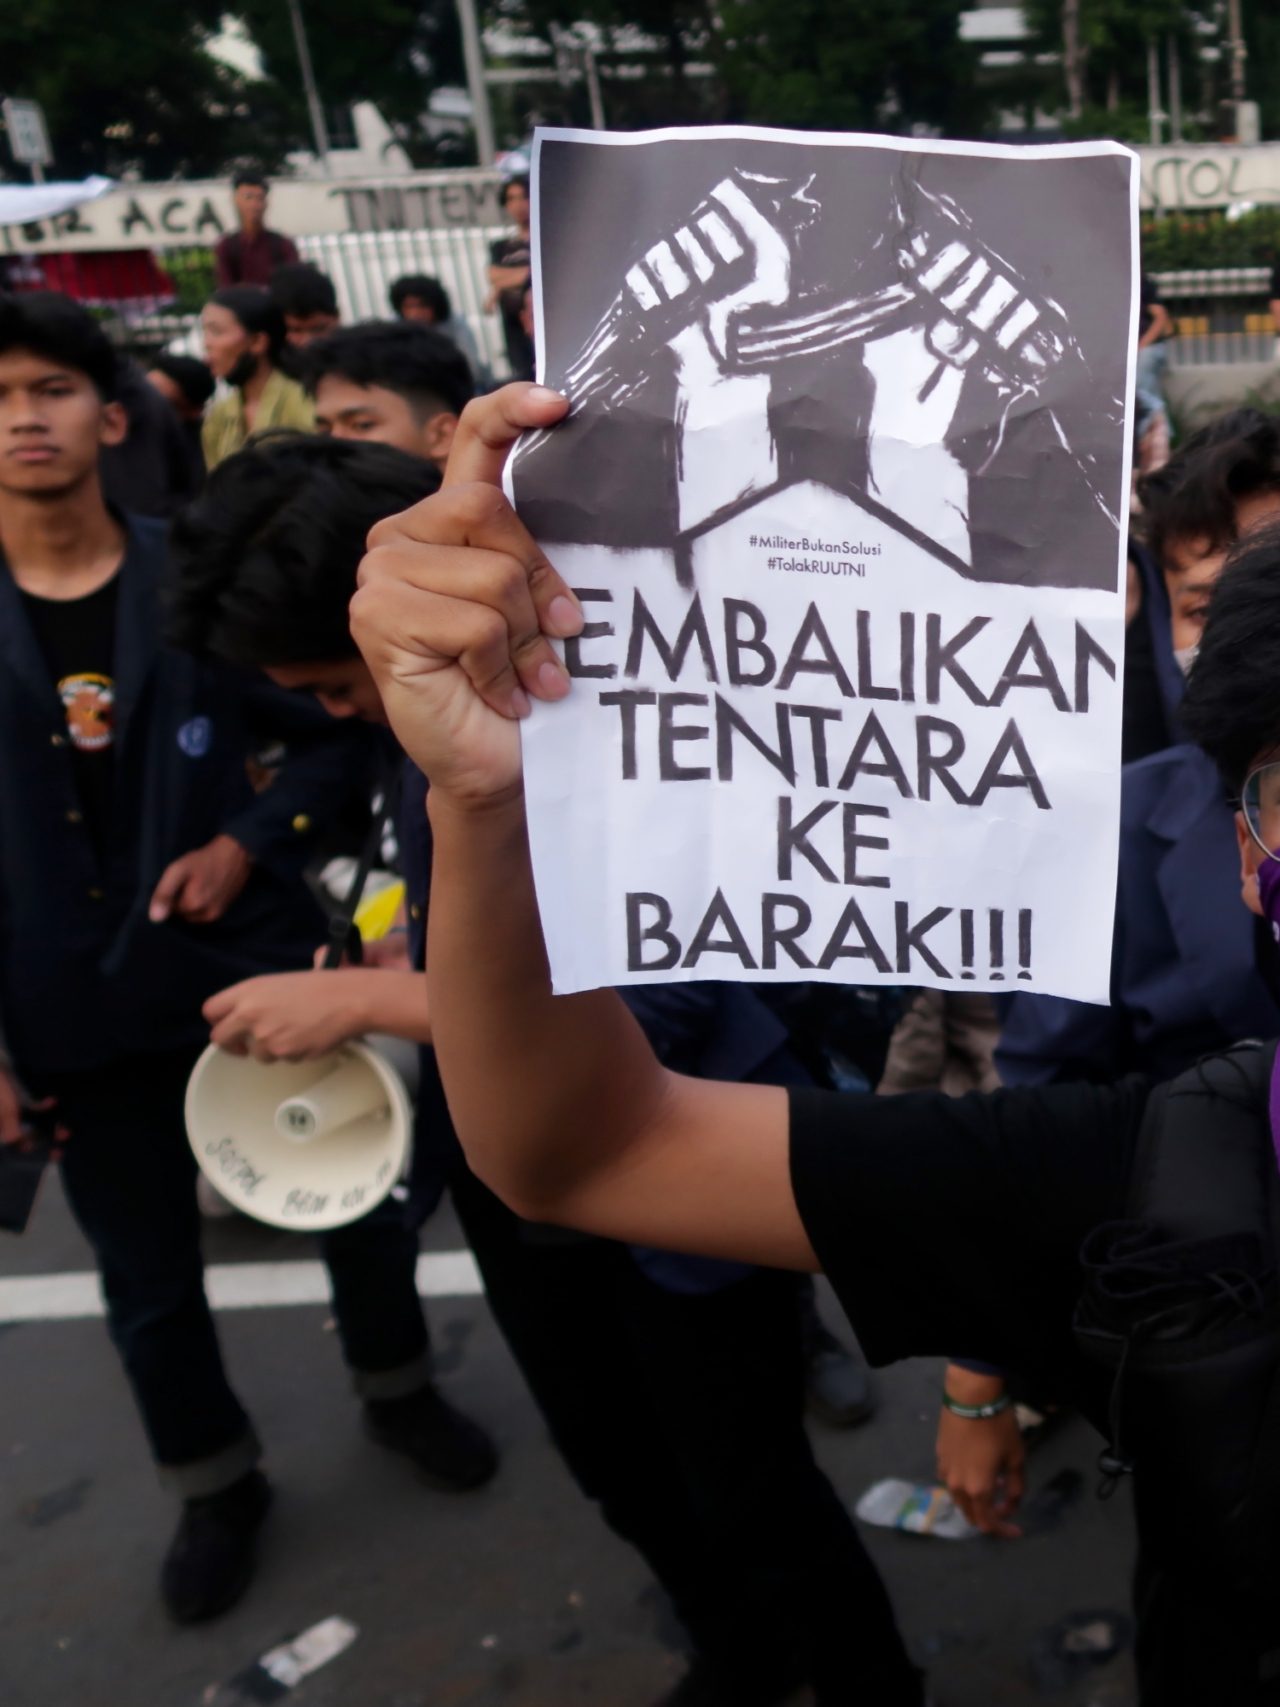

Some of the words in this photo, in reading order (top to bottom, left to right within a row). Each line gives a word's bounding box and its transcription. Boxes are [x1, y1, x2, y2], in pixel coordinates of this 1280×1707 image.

[749, 534, 882, 556] #MiliterBukanSolusi
[767, 556, 866, 578] #TolakRUUTNI
[599, 688, 1052, 809] TENTARA
[777, 796, 891, 888] KE
[625, 886, 1033, 982] BARAK!!!
